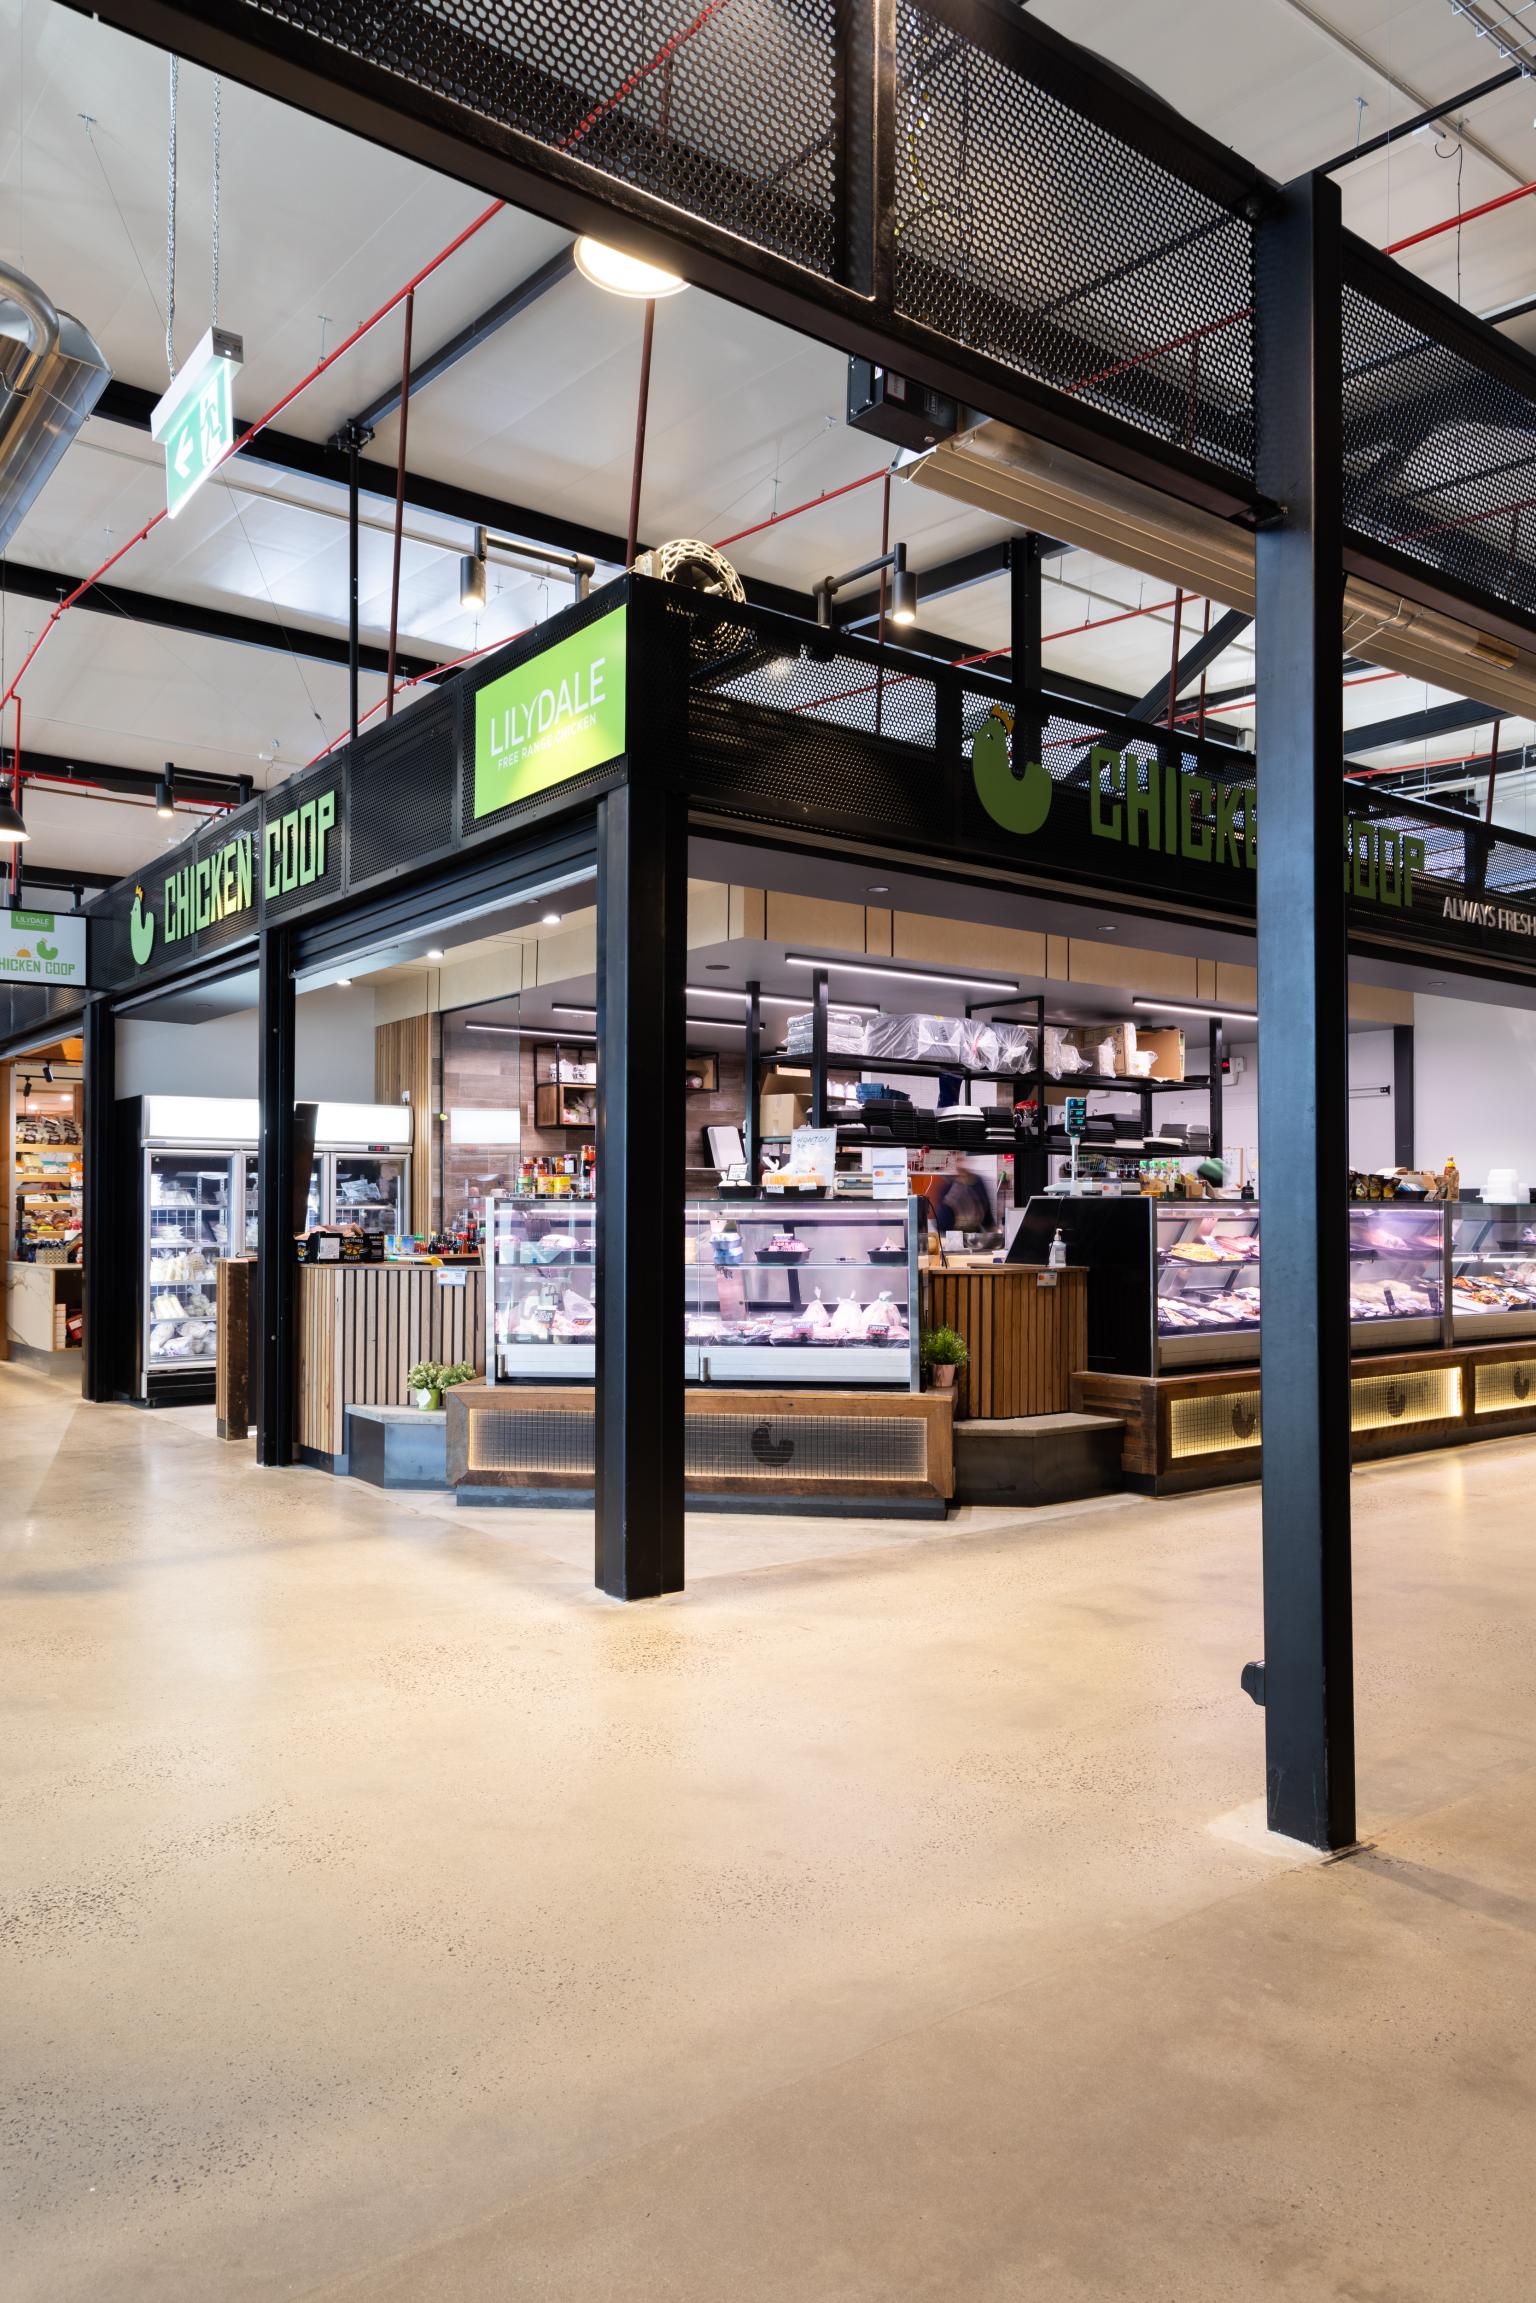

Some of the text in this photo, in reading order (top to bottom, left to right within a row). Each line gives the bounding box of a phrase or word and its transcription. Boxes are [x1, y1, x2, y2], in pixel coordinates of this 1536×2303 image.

[490, 657, 606, 756] LILYDALE
[498, 712, 598, 769] FREE RANGE CHICKEN
[1090, 747, 1425, 907] CHICK OOP
[164, 790, 335, 944] CHICKEN COOP
[15, 915, 49, 926] LILYDALE
[1443, 896, 1536, 936] ALWAYS FRESH
[0, 957, 75, 976] HICKEN COOP
